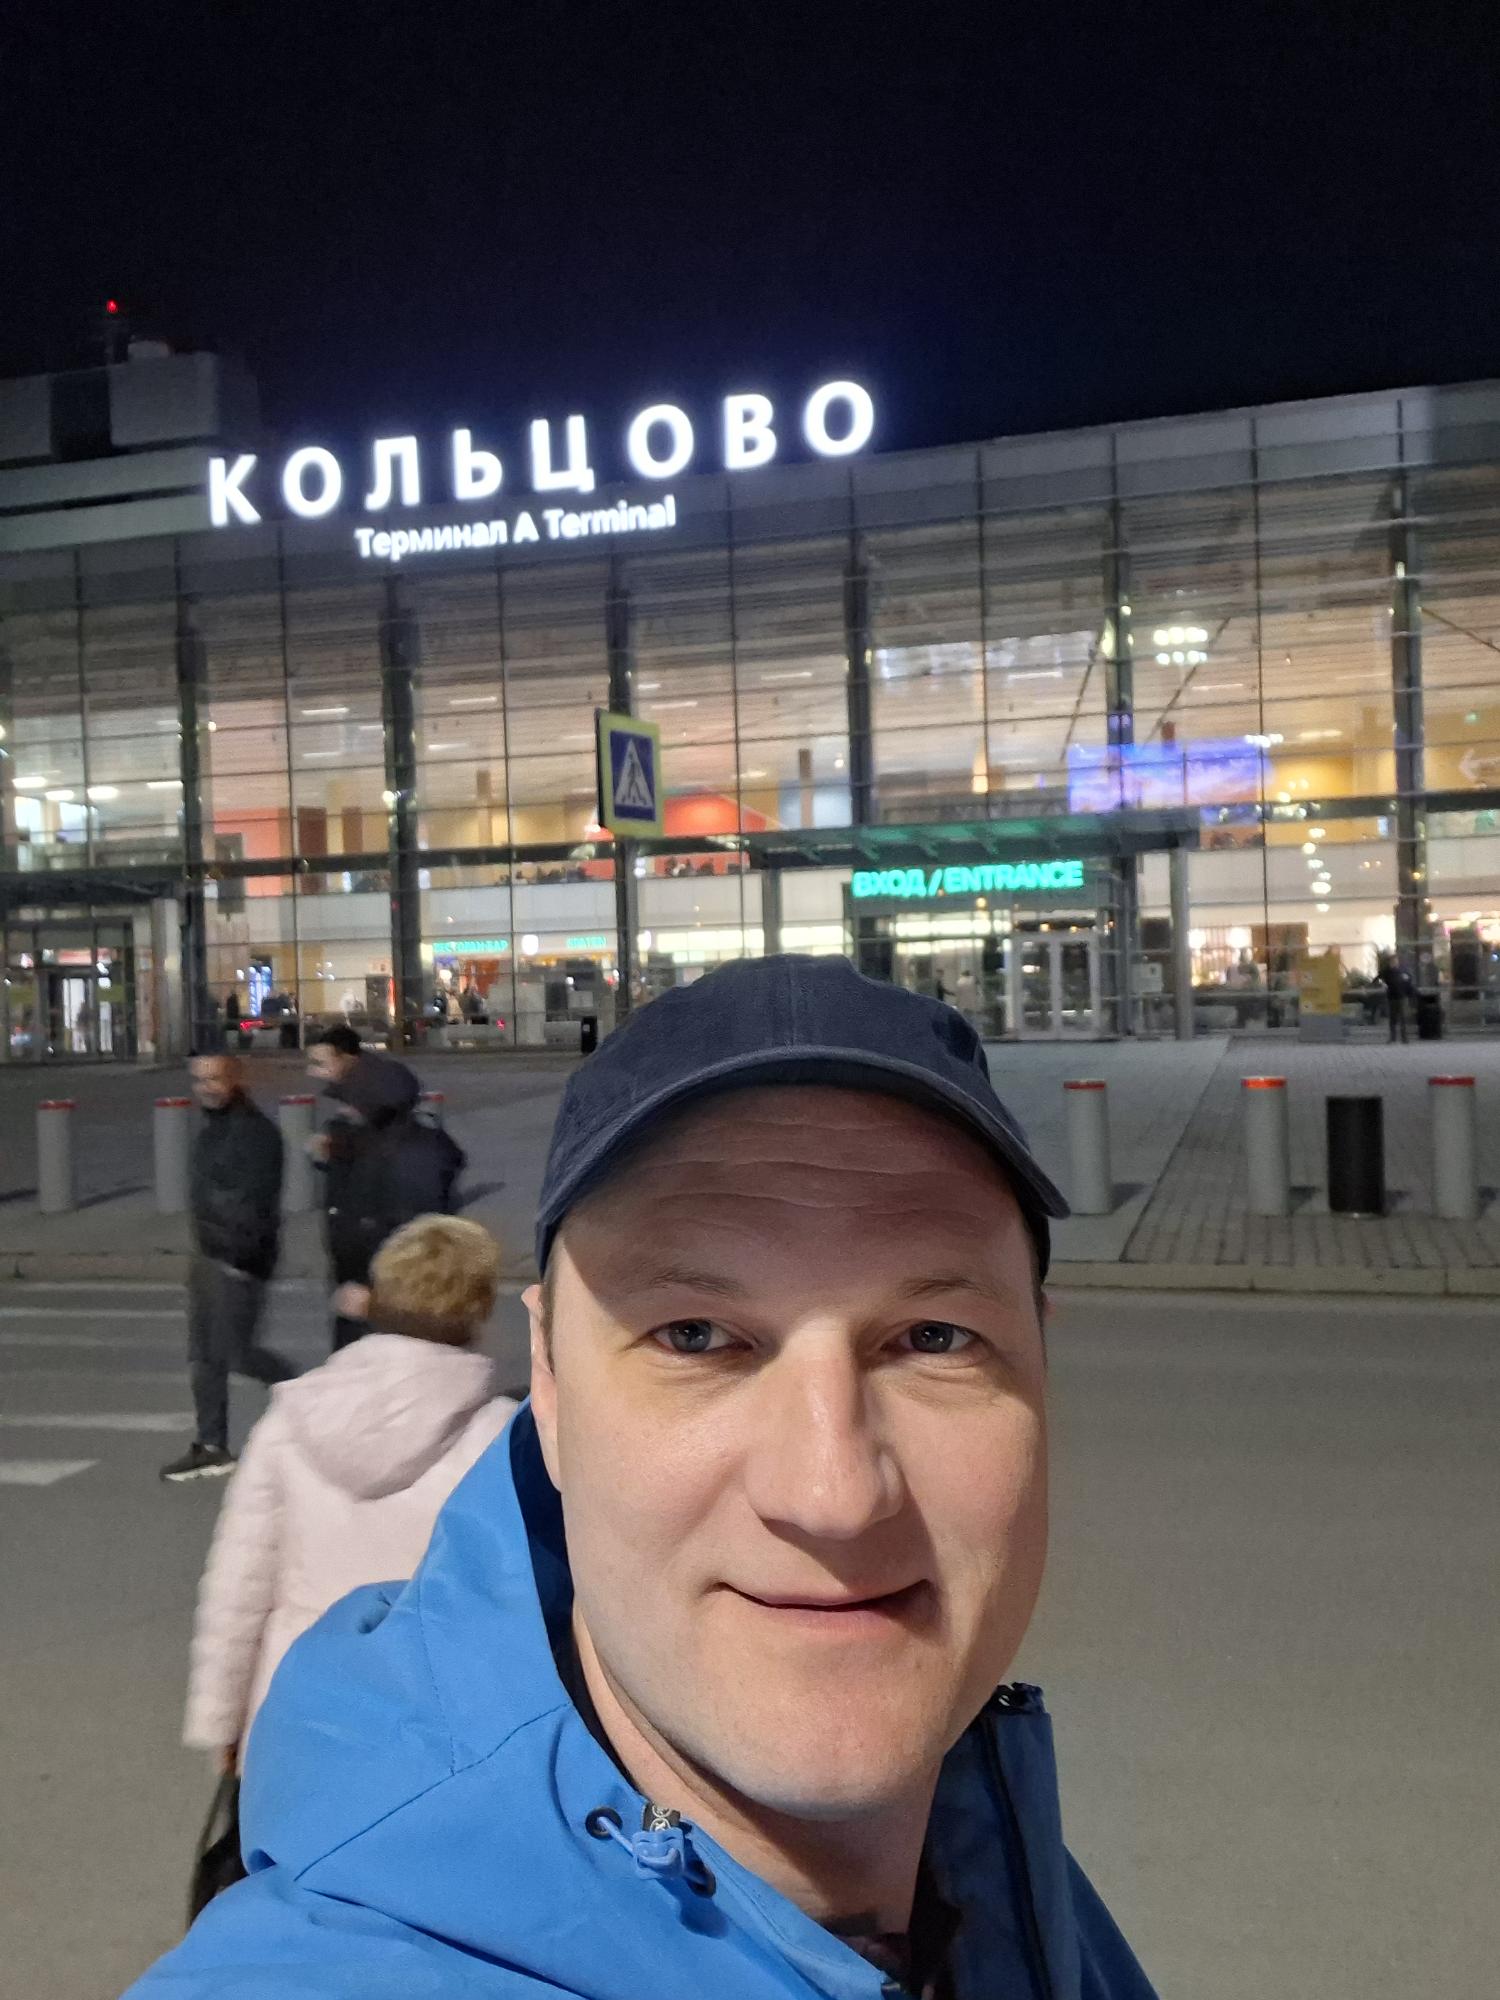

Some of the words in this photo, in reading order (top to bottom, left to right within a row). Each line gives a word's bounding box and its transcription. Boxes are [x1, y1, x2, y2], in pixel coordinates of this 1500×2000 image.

[208, 380, 875, 526] КОЛЬЦОВО
[355, 520, 507, 561] Терминал
[543, 494, 676, 539] Terminal
[852, 870, 926, 898] ВХОД
[943, 860, 1084, 893] ENTRANCE
